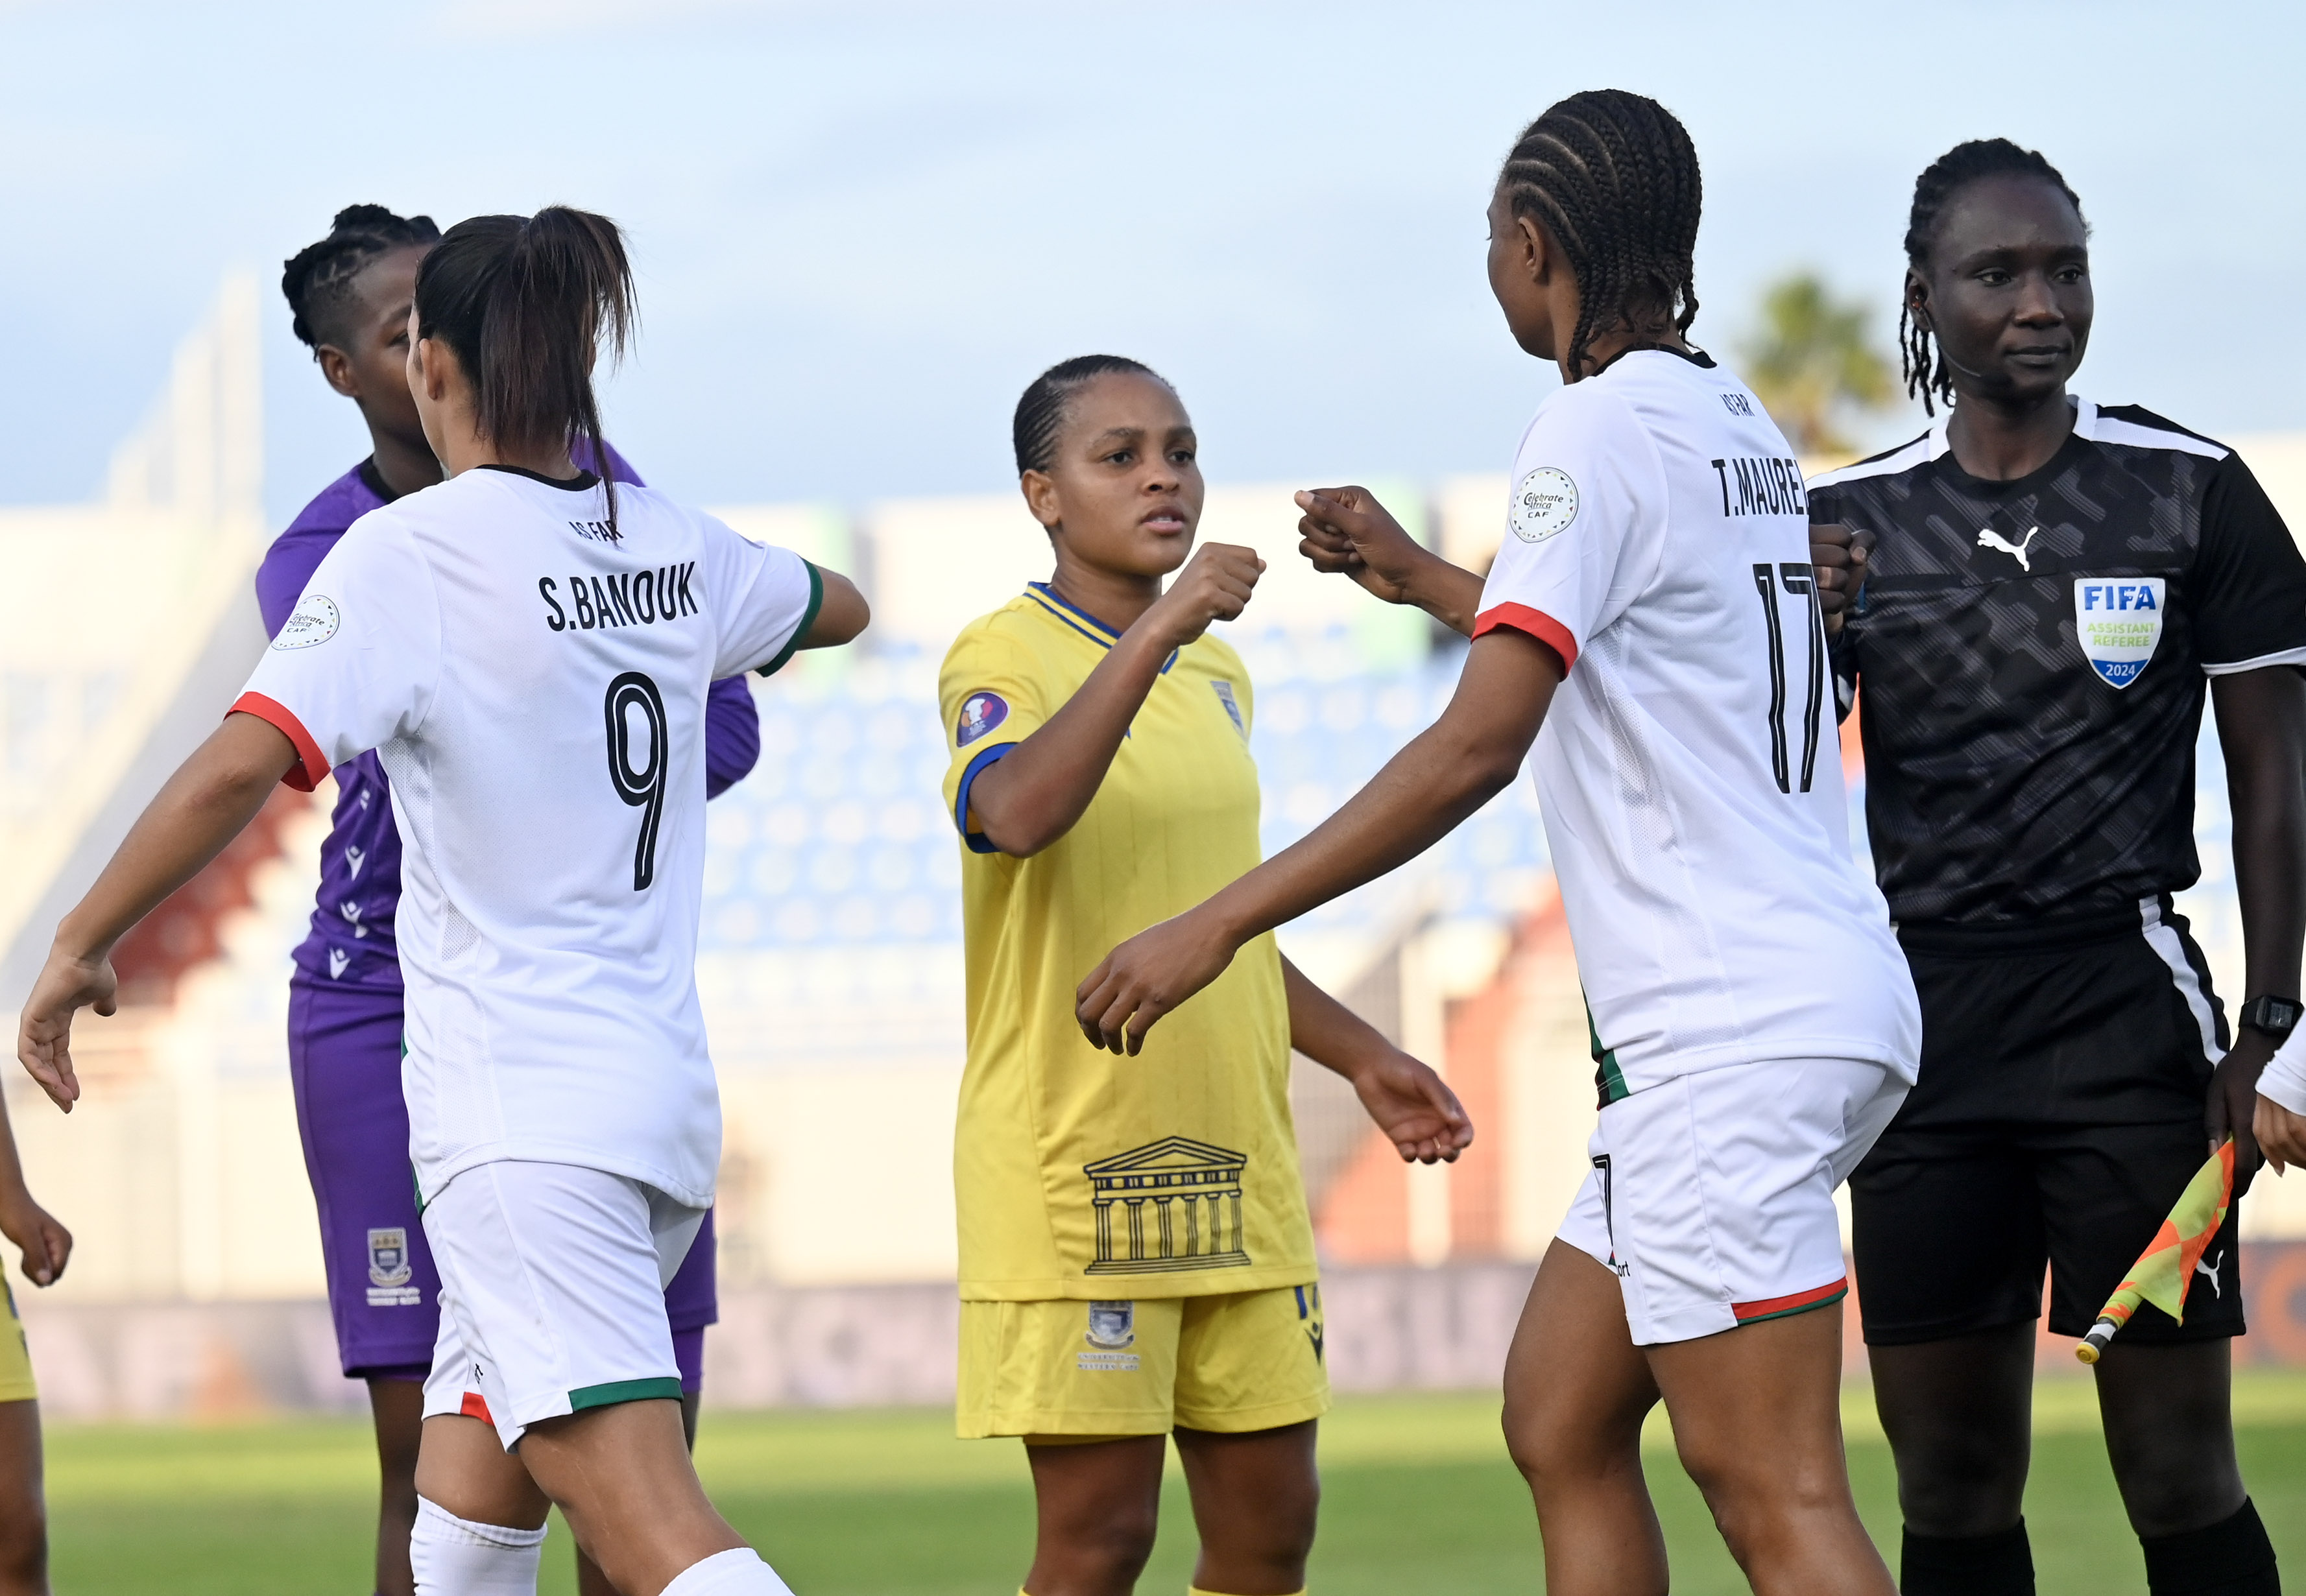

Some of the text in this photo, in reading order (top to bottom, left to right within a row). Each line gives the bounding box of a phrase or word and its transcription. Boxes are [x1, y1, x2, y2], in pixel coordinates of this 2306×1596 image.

[1729, 394, 1755, 417] FAR
[1524, 492, 1564, 506] Celebrate
[1528, 501, 1552, 510] Africa
[568, 520, 624, 542] AS FAR
[538, 561, 699, 632] S.BANOUK
[2084, 585, 2157, 610] FIFA
[2087, 623, 2156, 634] ASSISTANT
[2093, 636, 2150, 647] REFEREE
[1752, 563, 1824, 794] 17
[2105, 664, 2135, 676] 2024
[604, 671, 668, 892] 9
